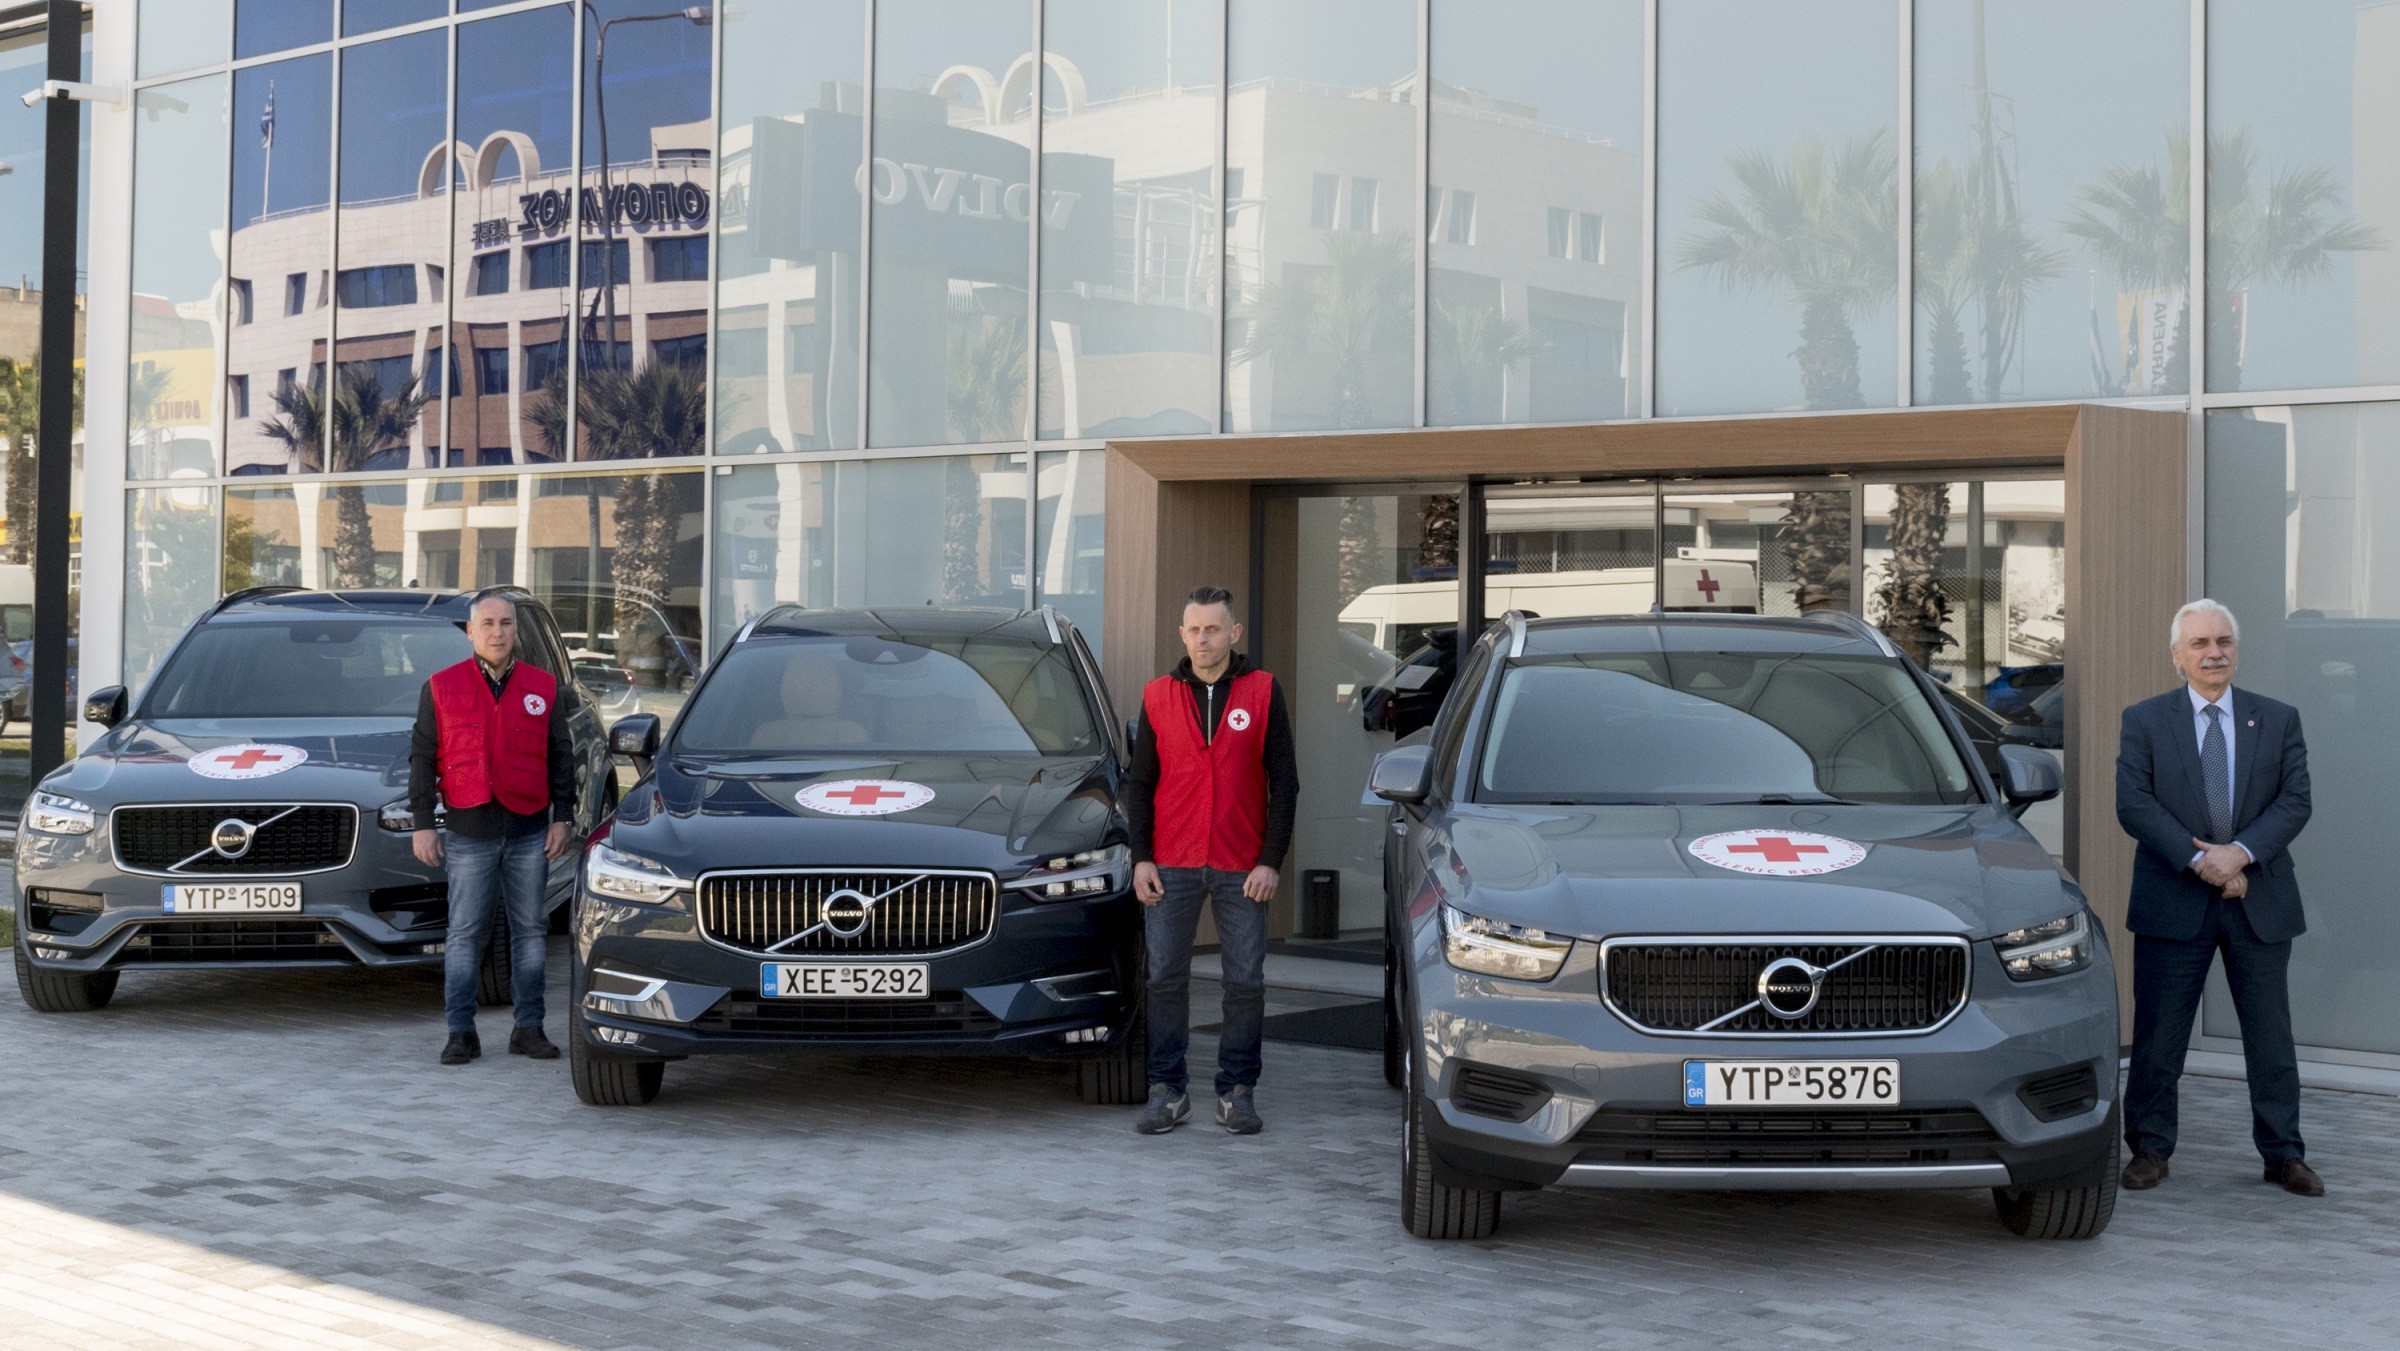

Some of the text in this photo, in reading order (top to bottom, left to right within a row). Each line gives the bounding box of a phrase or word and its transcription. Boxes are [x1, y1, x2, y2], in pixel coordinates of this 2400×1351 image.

[1788, 867, 1823, 875] RED
[764, 983, 776, 991] GR
[1768, 985, 1811, 993] VOLVO
[1688, 1088, 1704, 1098] GR
